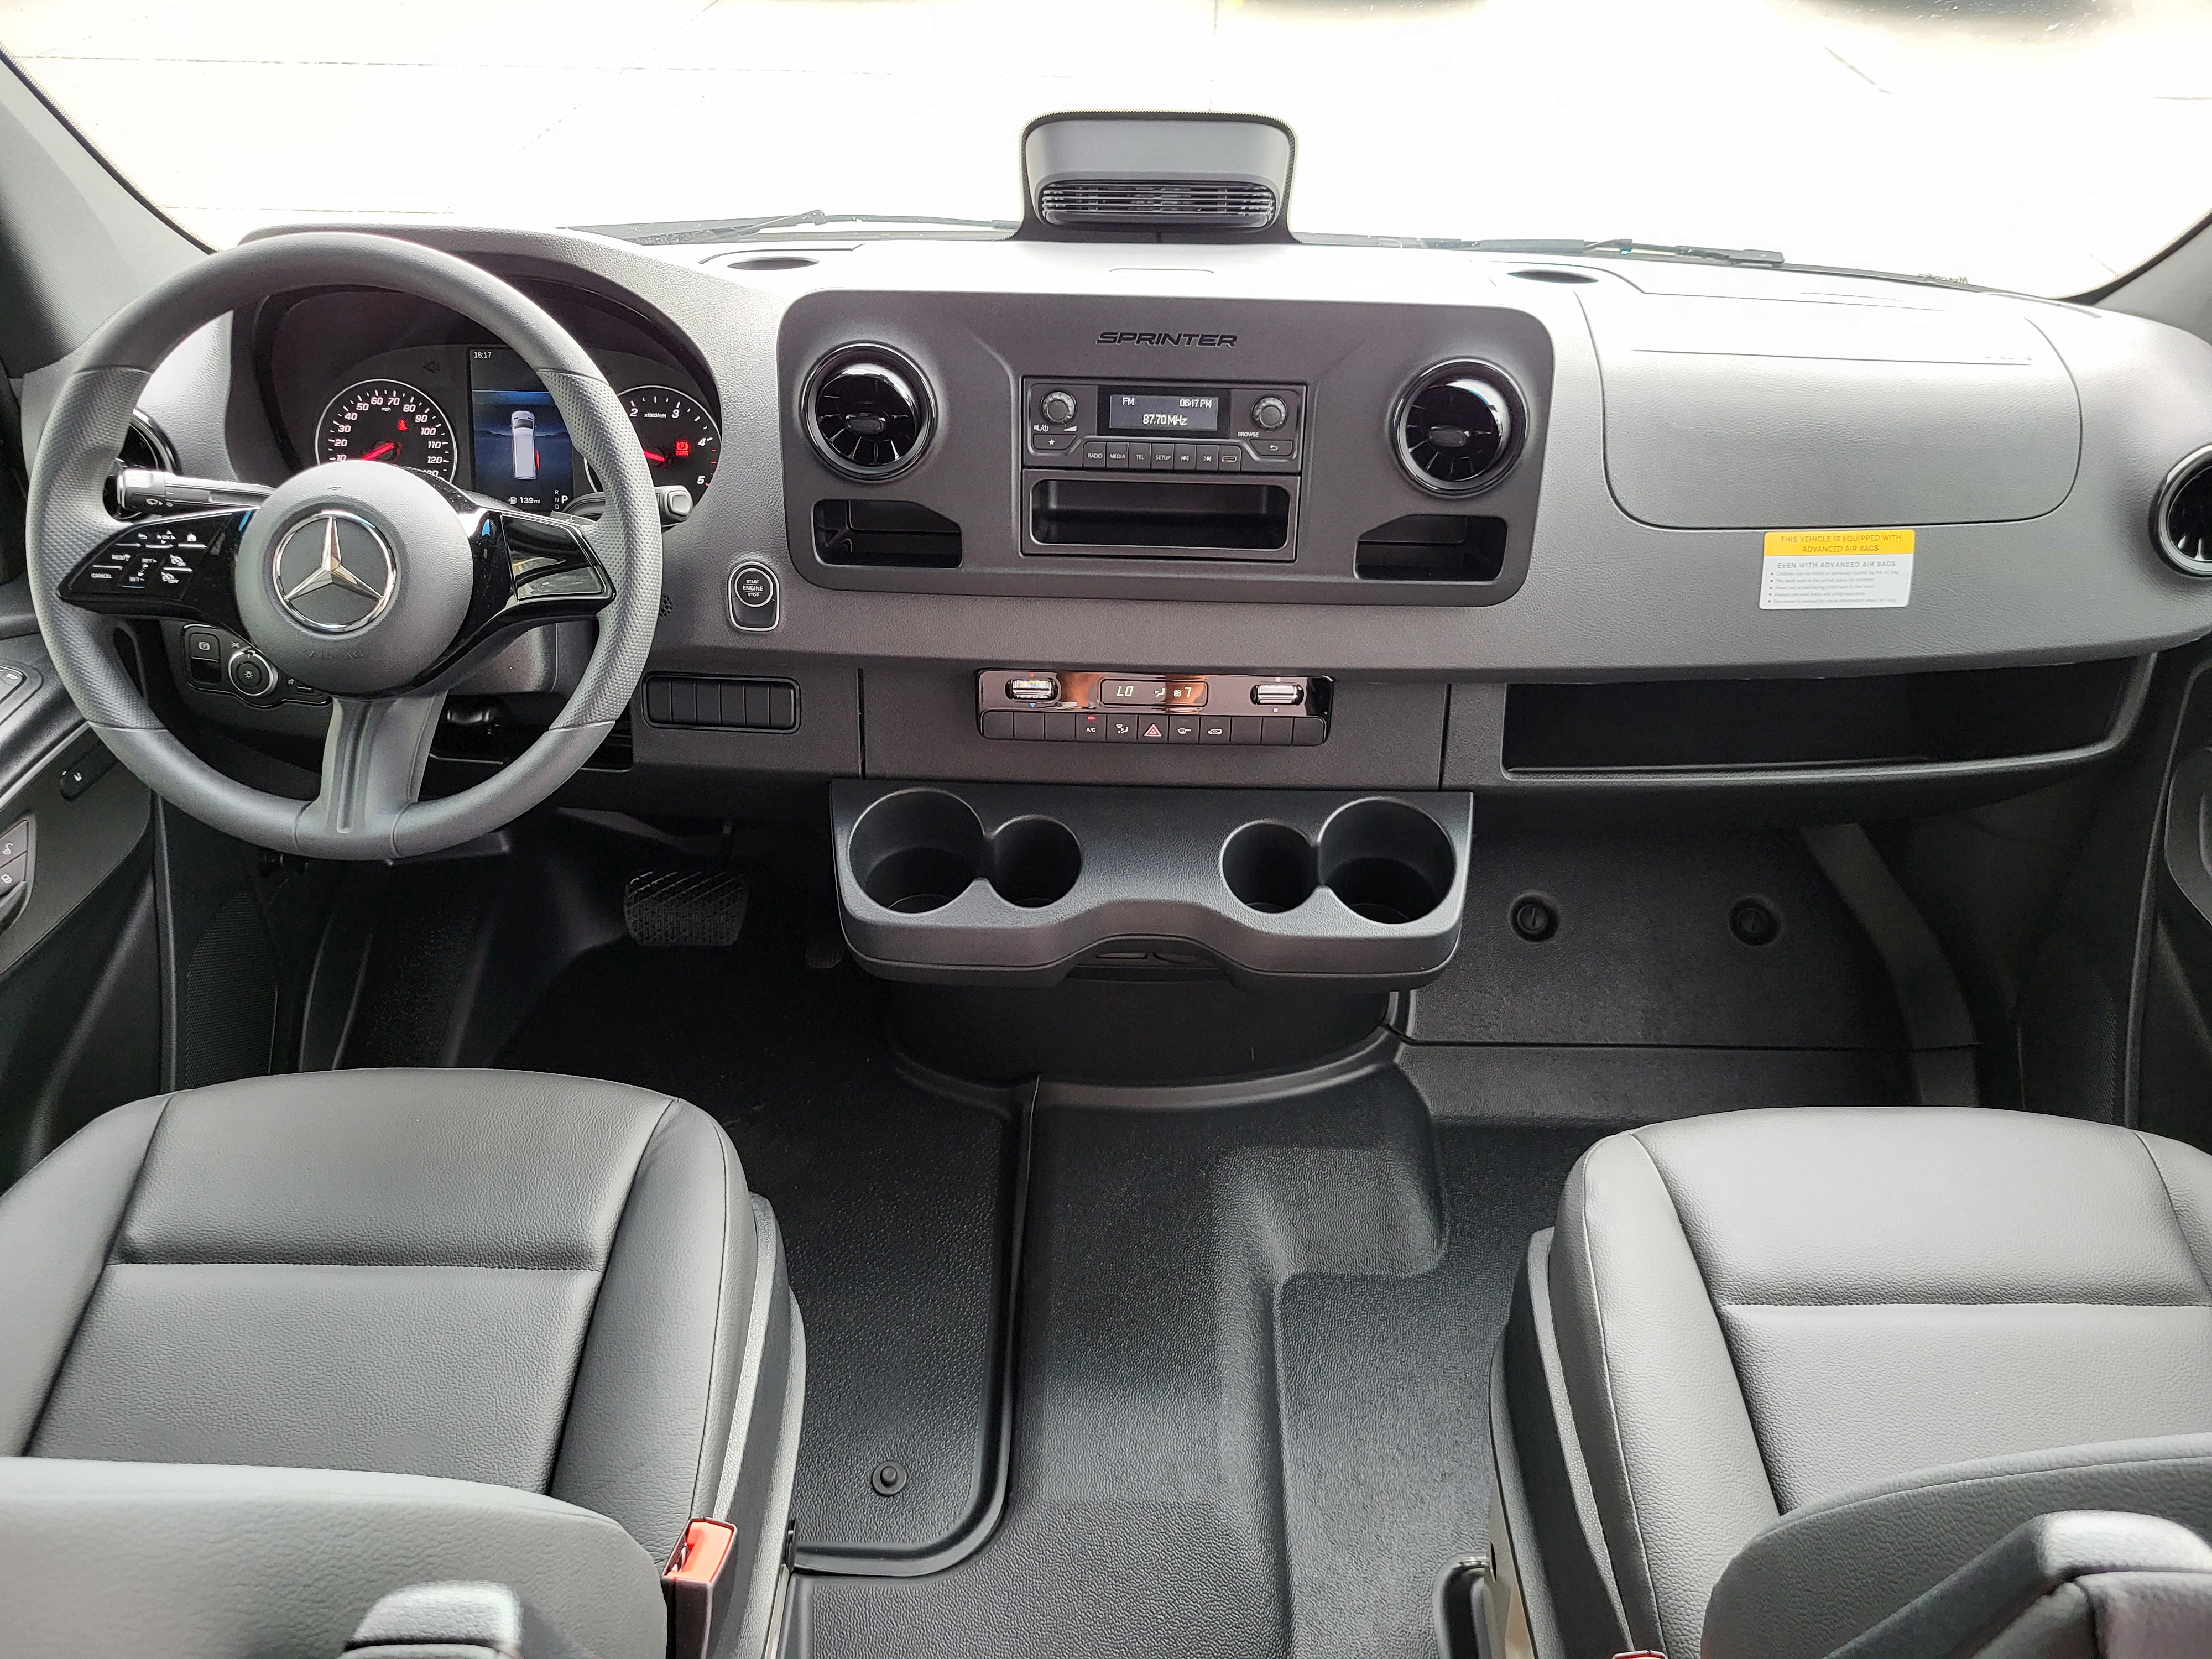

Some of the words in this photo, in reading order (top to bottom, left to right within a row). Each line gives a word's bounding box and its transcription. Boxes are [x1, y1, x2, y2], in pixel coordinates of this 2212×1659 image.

[1096, 332, 1237, 347] SPRINTER
[1123, 398, 1135, 406] FM
[1200, 399, 1212, 408] PM
[403, 404, 416, 413] 80
[629, 408, 638, 417] 2
[345, 413, 358, 421] 40
[671, 409, 680, 418] 3
[1142, 414, 1167, 425] 87.70
[1167, 416, 1188, 426] MHz
[428, 441, 441, 449] 110
[697, 437, 706, 446] 4
[696, 476, 705, 484] 5
[561, 495, 568, 504] P
[1185, 686, 1192, 697] 7
